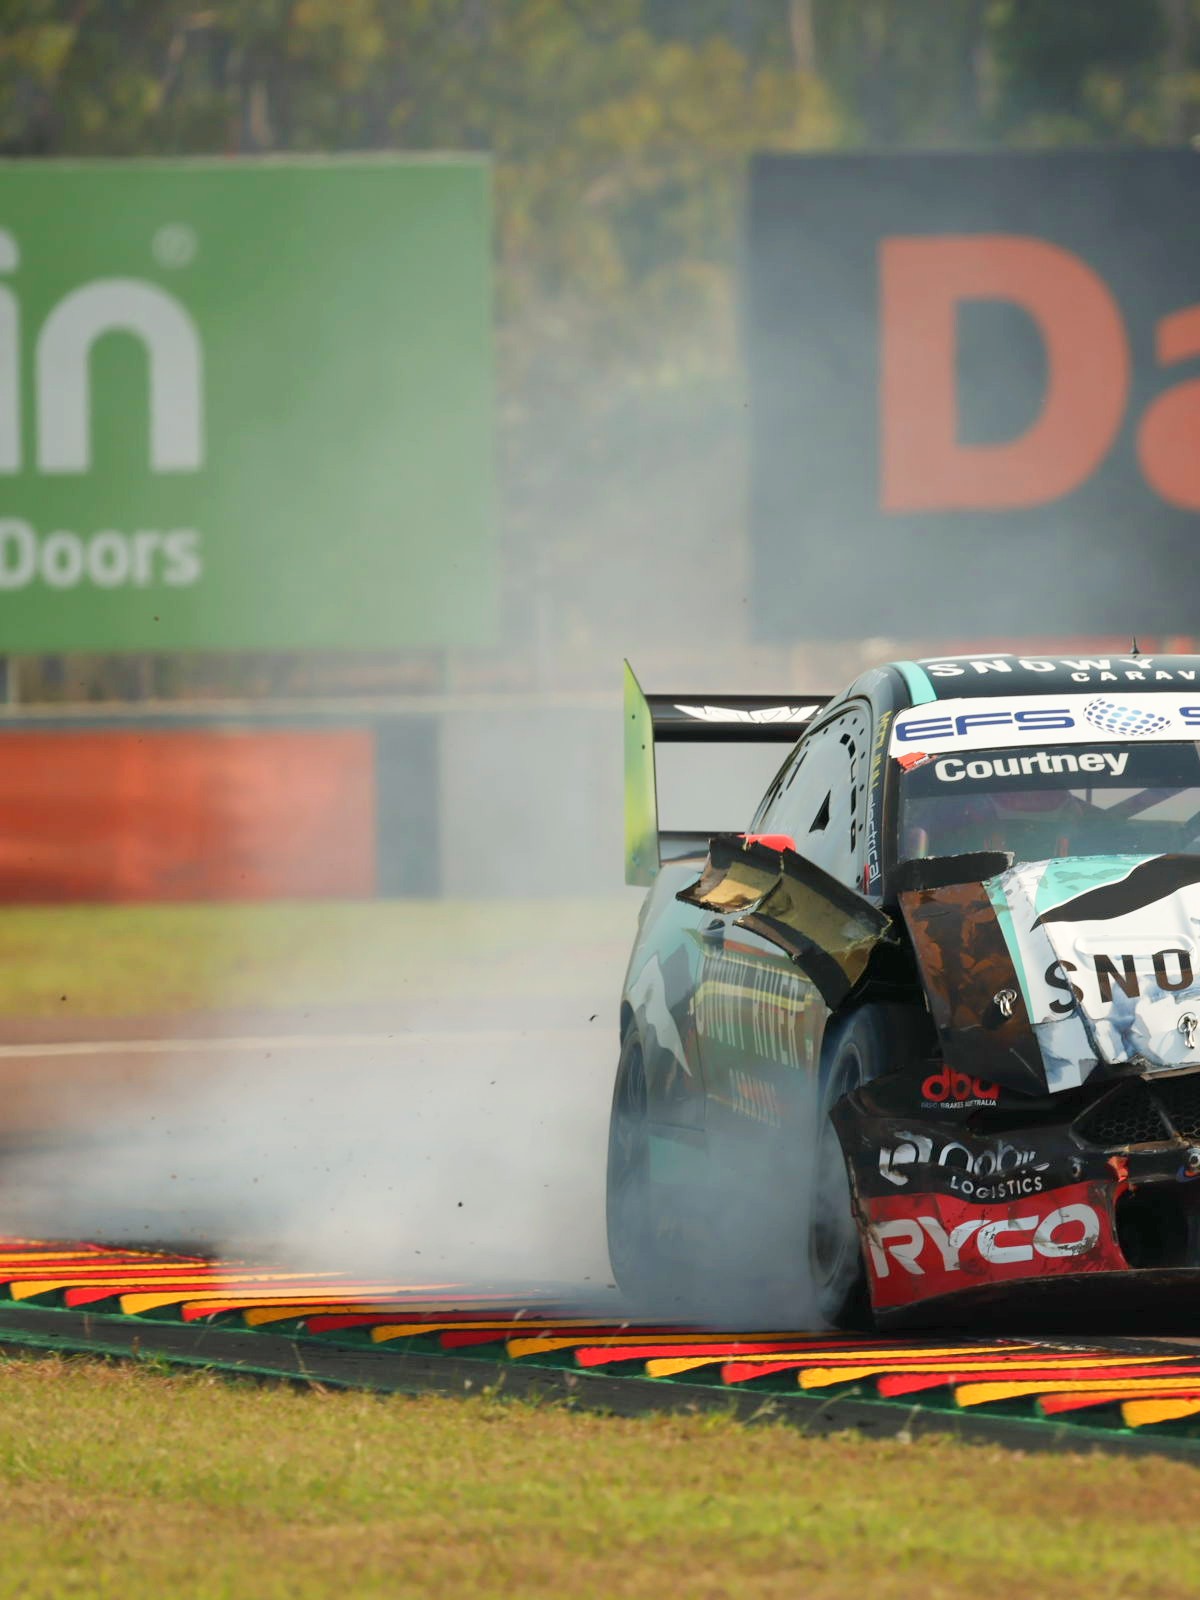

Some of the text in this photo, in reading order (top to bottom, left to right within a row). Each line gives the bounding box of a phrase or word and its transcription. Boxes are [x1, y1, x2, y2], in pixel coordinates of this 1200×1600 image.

[0, 517, 202, 589] Doors
[927, 658, 1155, 678] SNOWY
[895, 708, 1075, 742] EFS
[935, 752, 1129, 782] Courtney
[950, 1175, 1044, 1199] LOGISTICS
[868, 1203, 1100, 1279] RYCO
